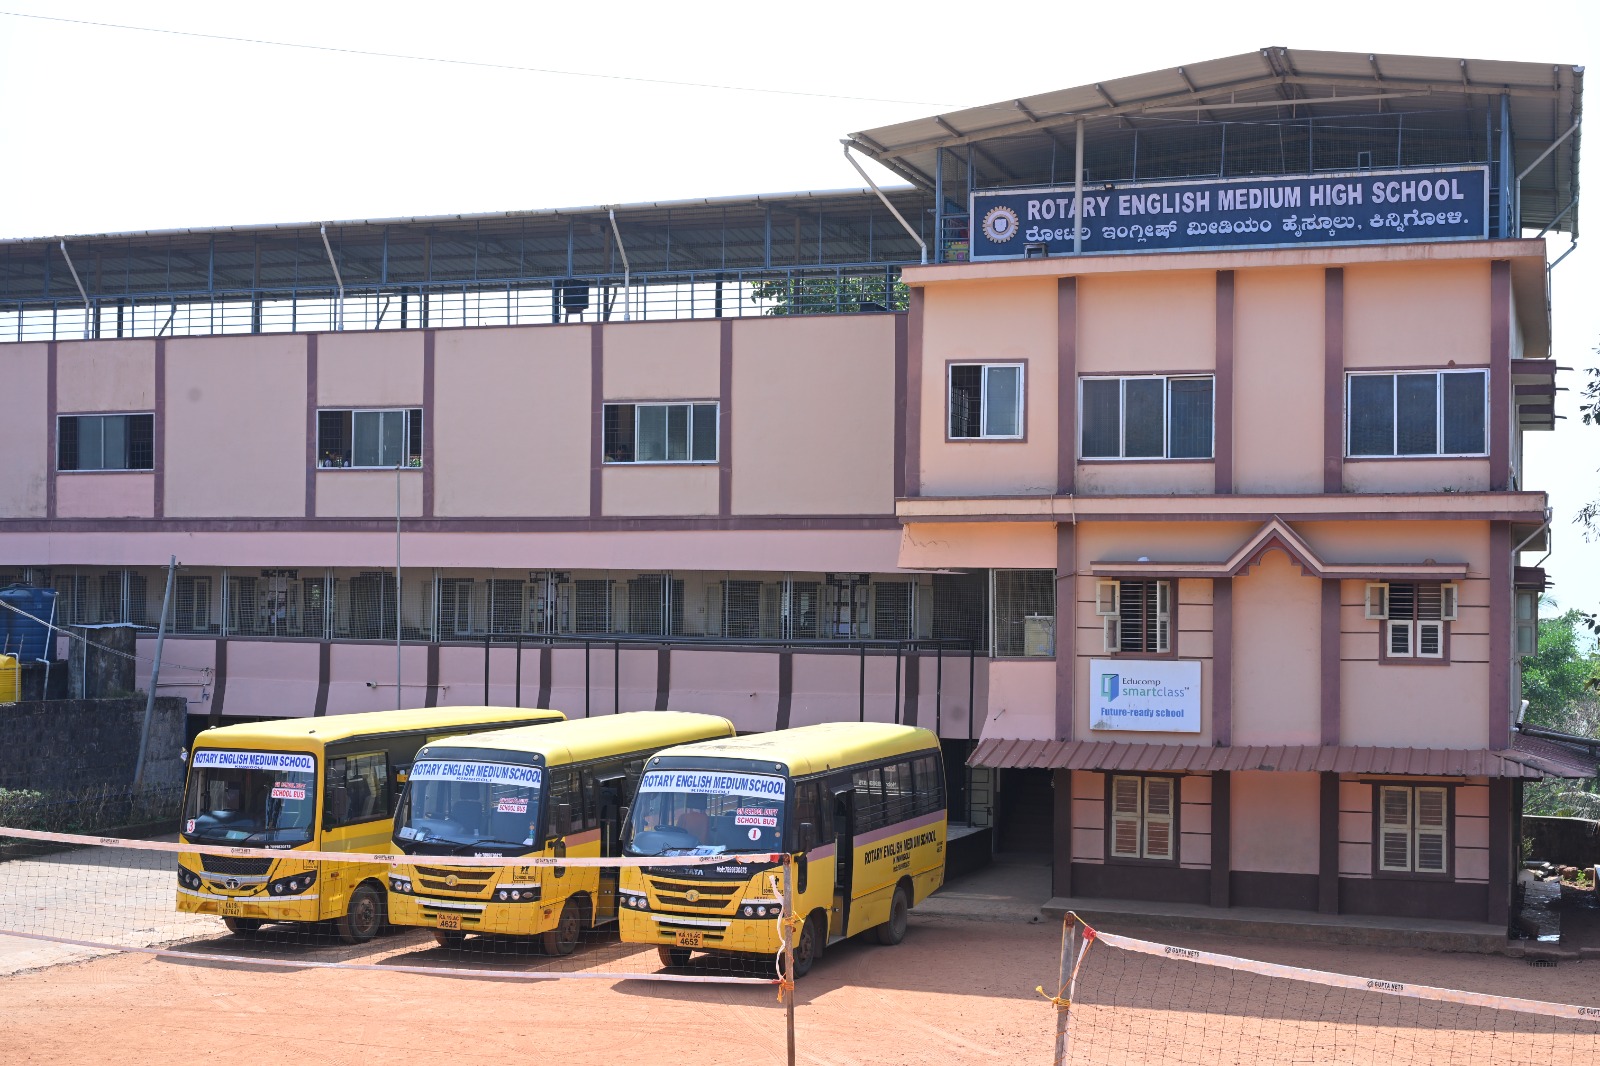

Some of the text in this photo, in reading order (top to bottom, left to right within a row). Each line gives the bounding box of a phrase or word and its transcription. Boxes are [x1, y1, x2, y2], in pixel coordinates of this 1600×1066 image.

[1027, 178, 1465, 220] ROTARY ENGLISH MEDIUM HIGH SCHOOL
[1122, 677, 1161, 687] Educomp
[1100, 707, 1185, 718] Future-ready school
[195, 751, 312, 769] ROTARY ENGLISH MEDIUM SCHOOL
[413, 763, 541, 783] ROTARY ENGLISH MEDIUM SCHOOL
[643, 774, 785, 796] ROTARY ENGLISH MEDIUM SCHOOL
[272, 789, 292, 797] SCHOOL
[737, 816, 761, 825] SCHOOL
[188, 820, 195, 832] 3
[864, 847, 883, 865] ROTARY
[884, 841, 903, 858] ENGLISH
[903, 835, 920, 851] MEDIUM
[920, 830, 937, 846] SCHOOL
[685, 868, 703, 876] TATA
[440, 920, 457, 928] 4622
[680, 938, 698, 946] 4652
[1374, 981, 1391, 989] GUPTA
